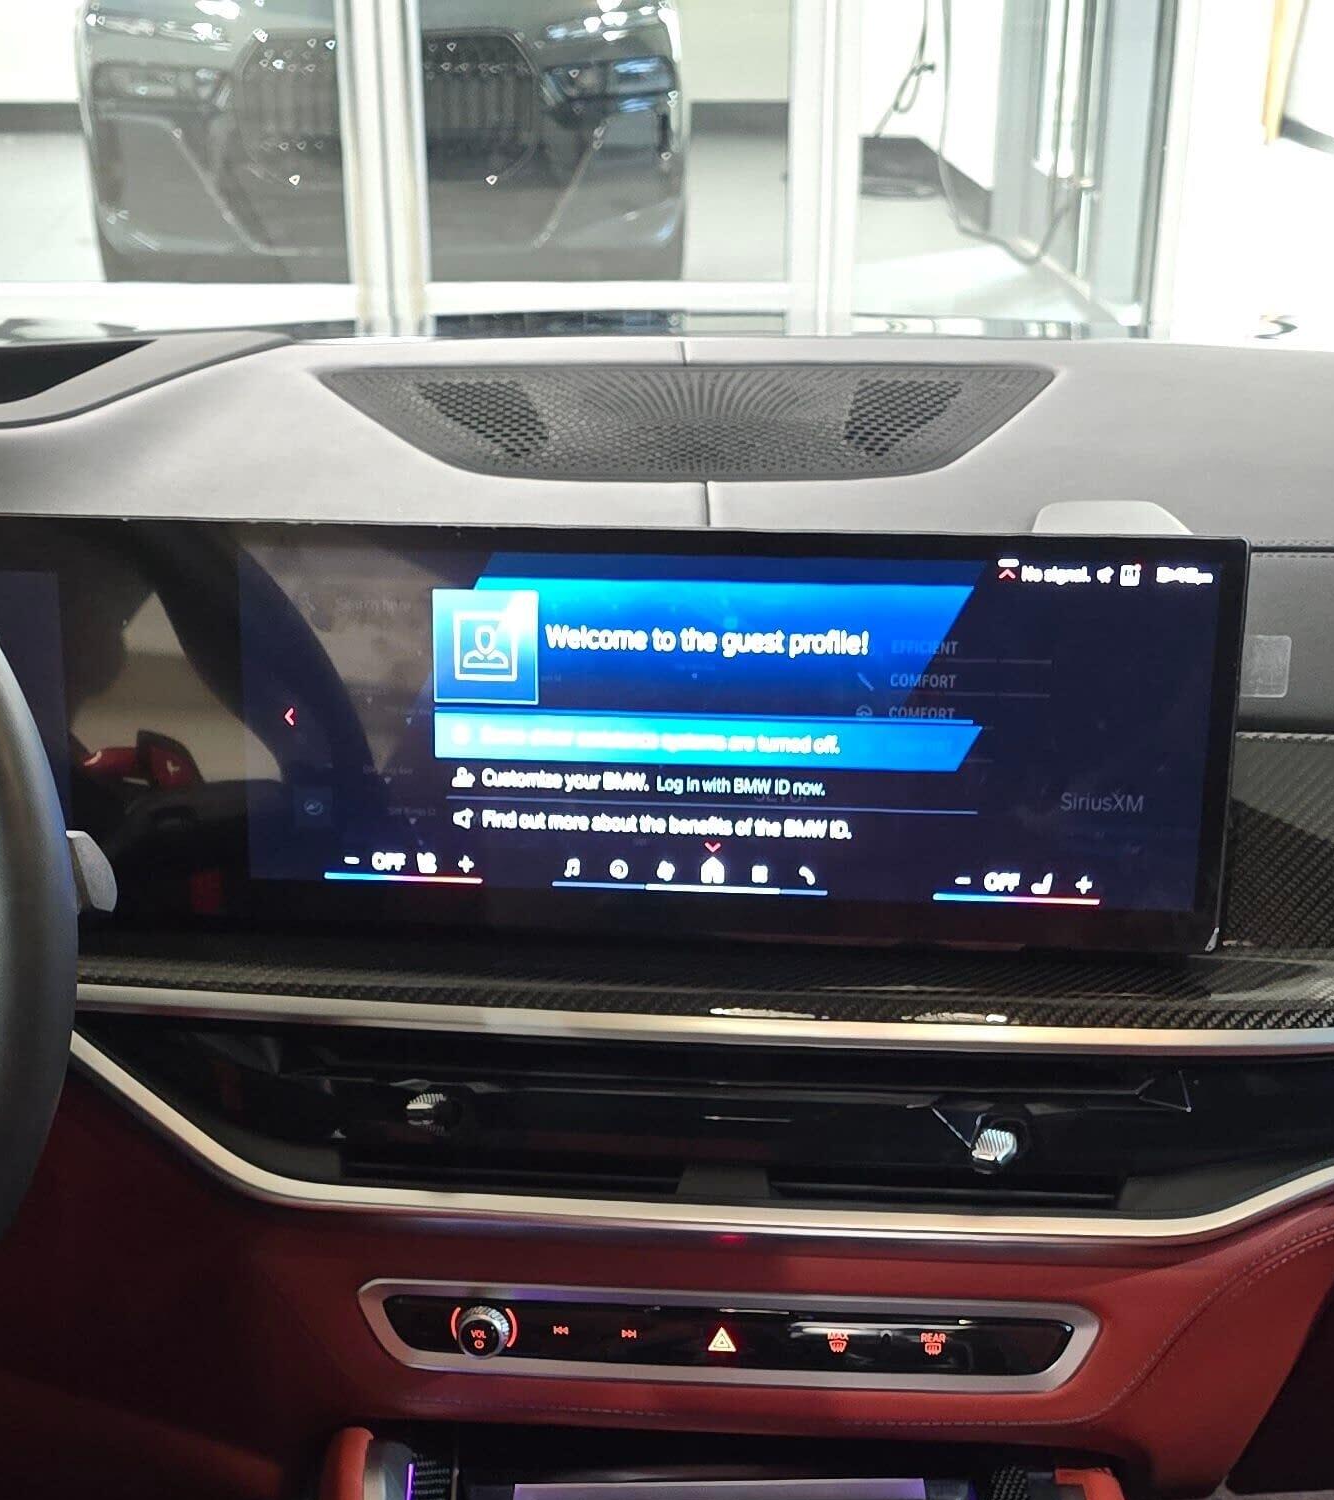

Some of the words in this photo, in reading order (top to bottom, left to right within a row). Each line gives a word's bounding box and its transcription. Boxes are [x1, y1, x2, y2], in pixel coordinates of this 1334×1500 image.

[545, 624, 648, 651] Welcome
[651, 627, 676, 653] to
[680, 627, 717, 653] the
[721, 629, 785, 658] guest
[788, 629, 870, 658] profile!
[890, 674, 956, 689] COMFORT
[481, 768, 563, 791] Customize
[564, 774, 601, 793] your
[602, 771, 650, 792] BMW.
[656, 776, 684, 795] Log
[686, 776, 700, 793] in
[702, 777, 731, 795] with
[733, 777, 771, 795] BMW
[774, 778, 791, 796] ID
[793, 781, 826, 797] now.
[1061, 791, 1145, 813] SiriusXM
[482, 809, 517, 829] Find
[518, 813, 547, 830] out
[548, 814, 590, 831] more
[591, 812, 637, 833] about
[640, 814, 666, 834] the
[668, 815, 733, 837] benefits
[735, 817, 753, 837] of
[755, 818, 781, 838] the
[783, 818, 828, 839] BMW
[371, 852, 406, 871] OFF
[983, 872, 1021, 892] OFF
[470, 1329, 487, 1339] VOL
[920, 1332, 946, 1343] REAR
